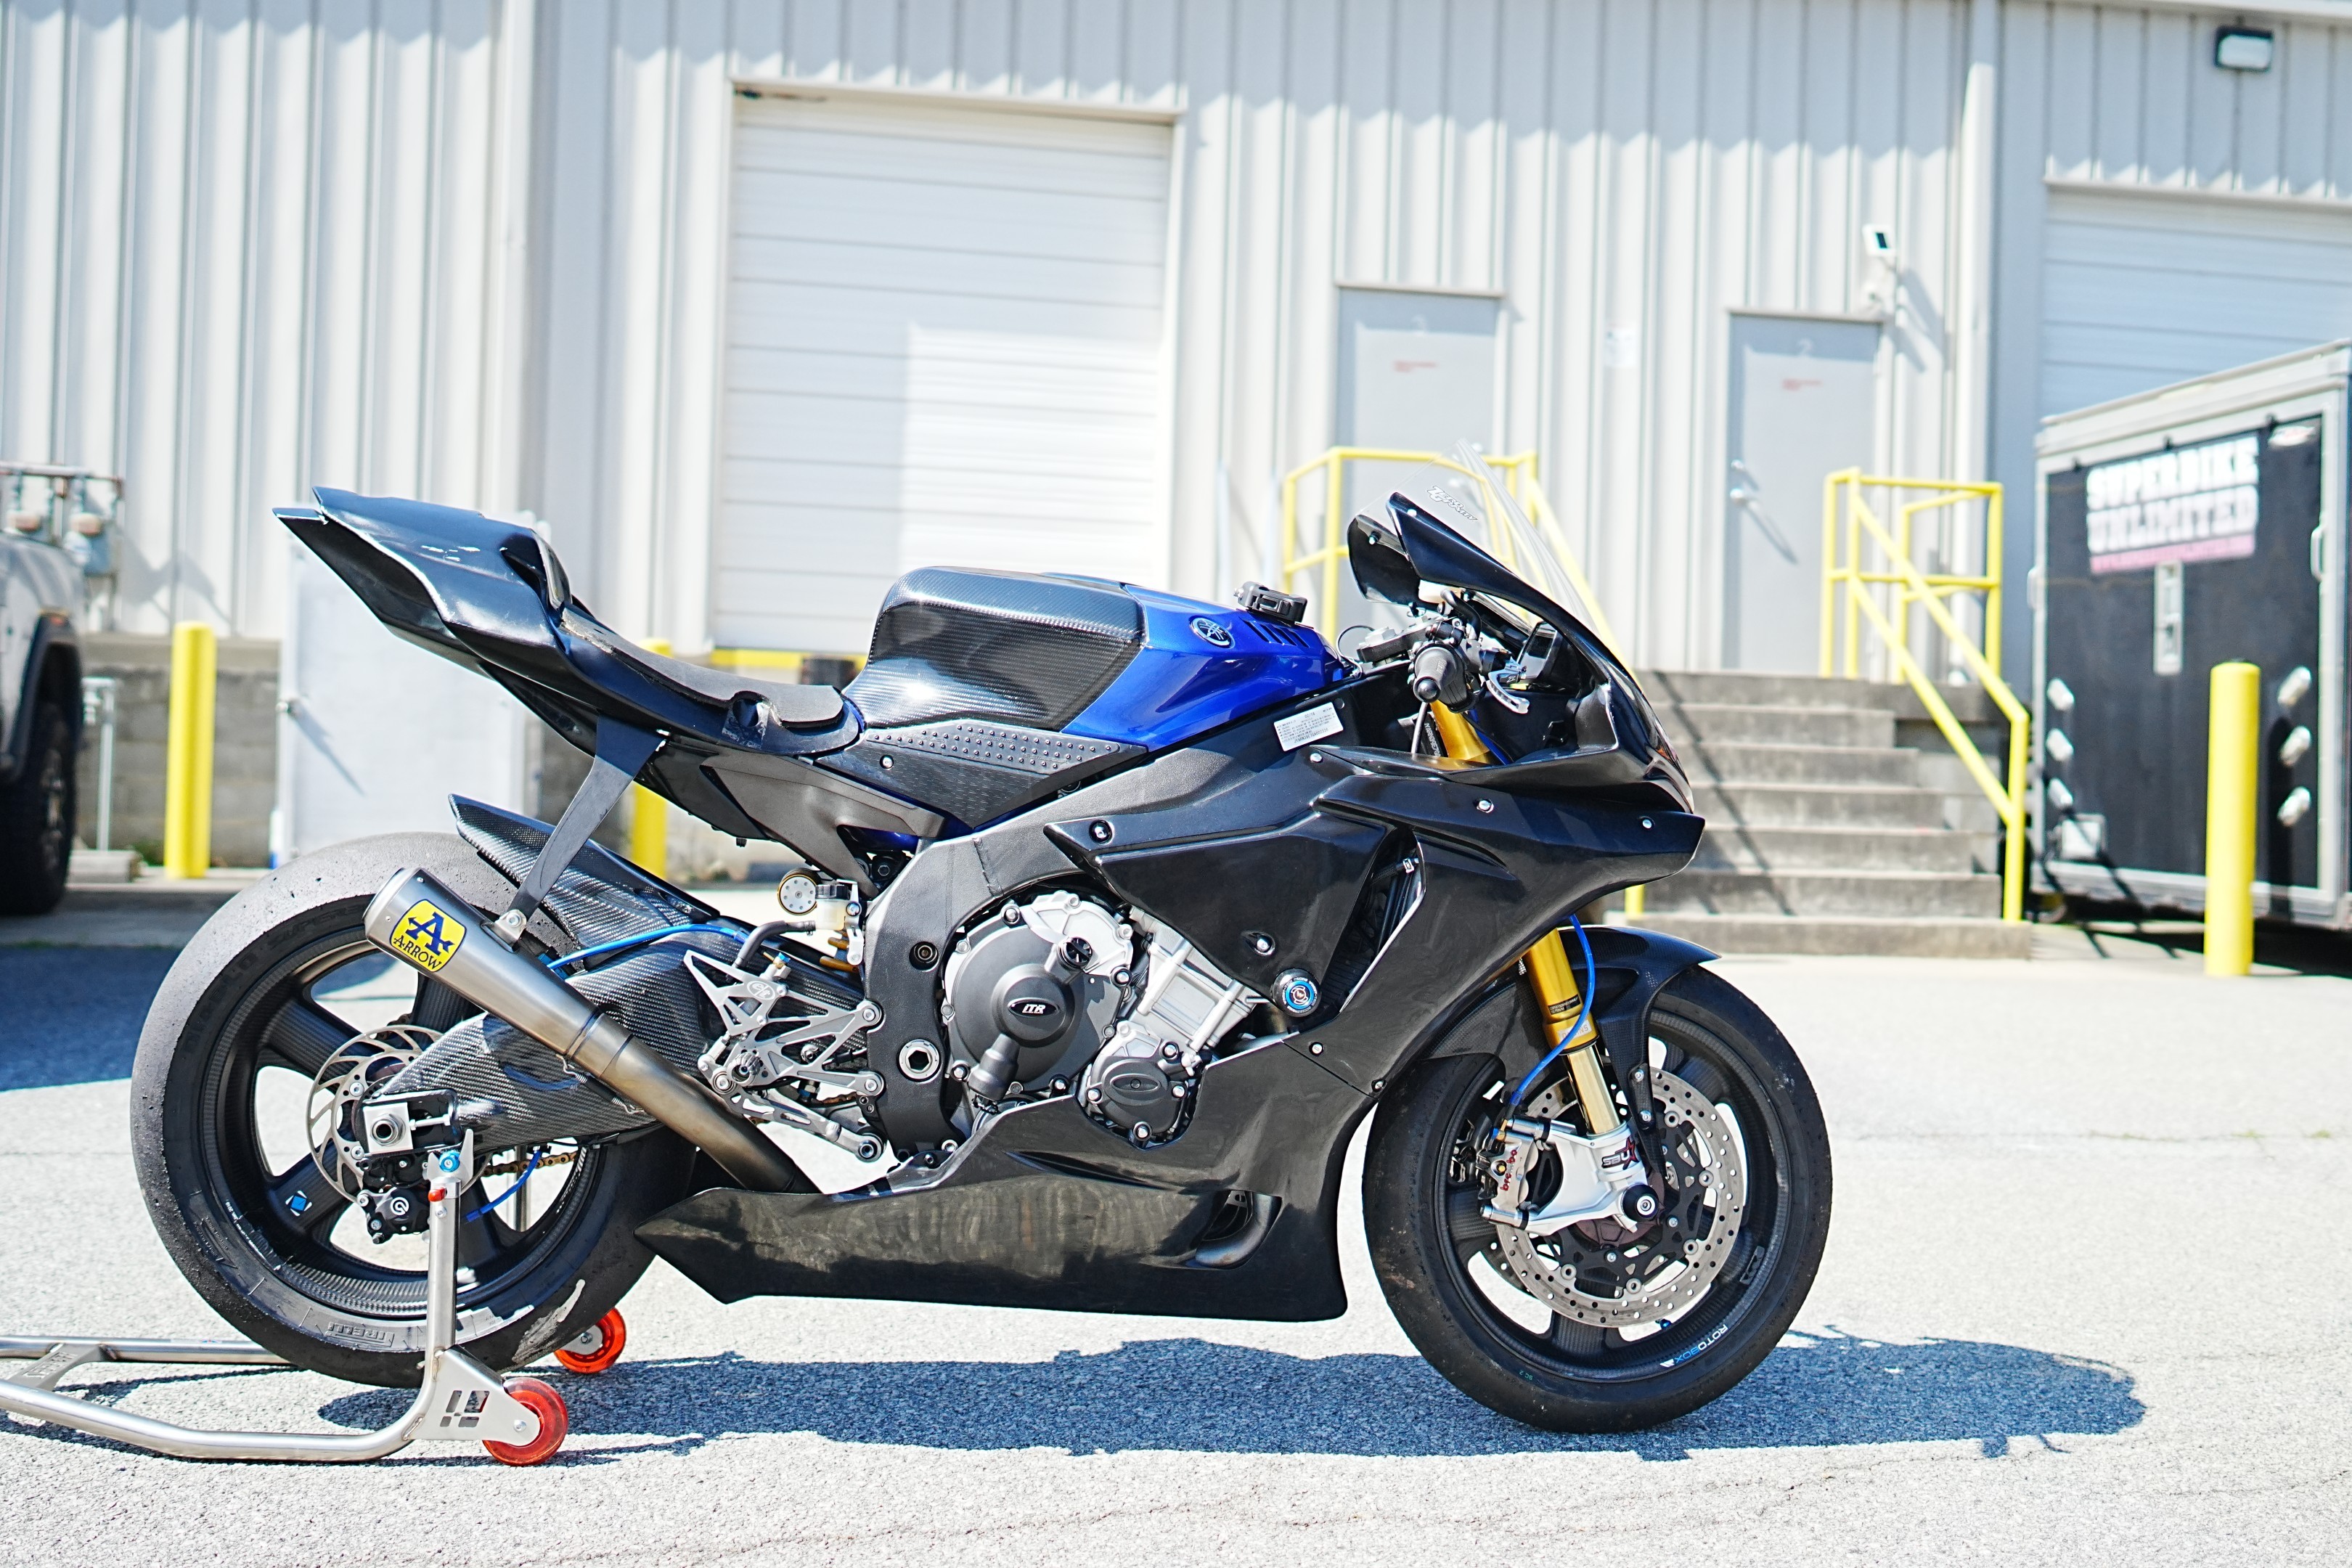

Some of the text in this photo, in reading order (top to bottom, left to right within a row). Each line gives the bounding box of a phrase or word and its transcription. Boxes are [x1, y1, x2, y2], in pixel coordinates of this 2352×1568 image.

[2086, 436, 2259, 510] SUPERBIKE
[2086, 483, 2258, 554] UNLIMITED
[393, 935, 442, 969] ARROW
[1500, 1149, 1517, 1191] brebo
[326, 1321, 394, 1347] PIRELLI
[1673, 1324, 1729, 1364] ROTOBOX
